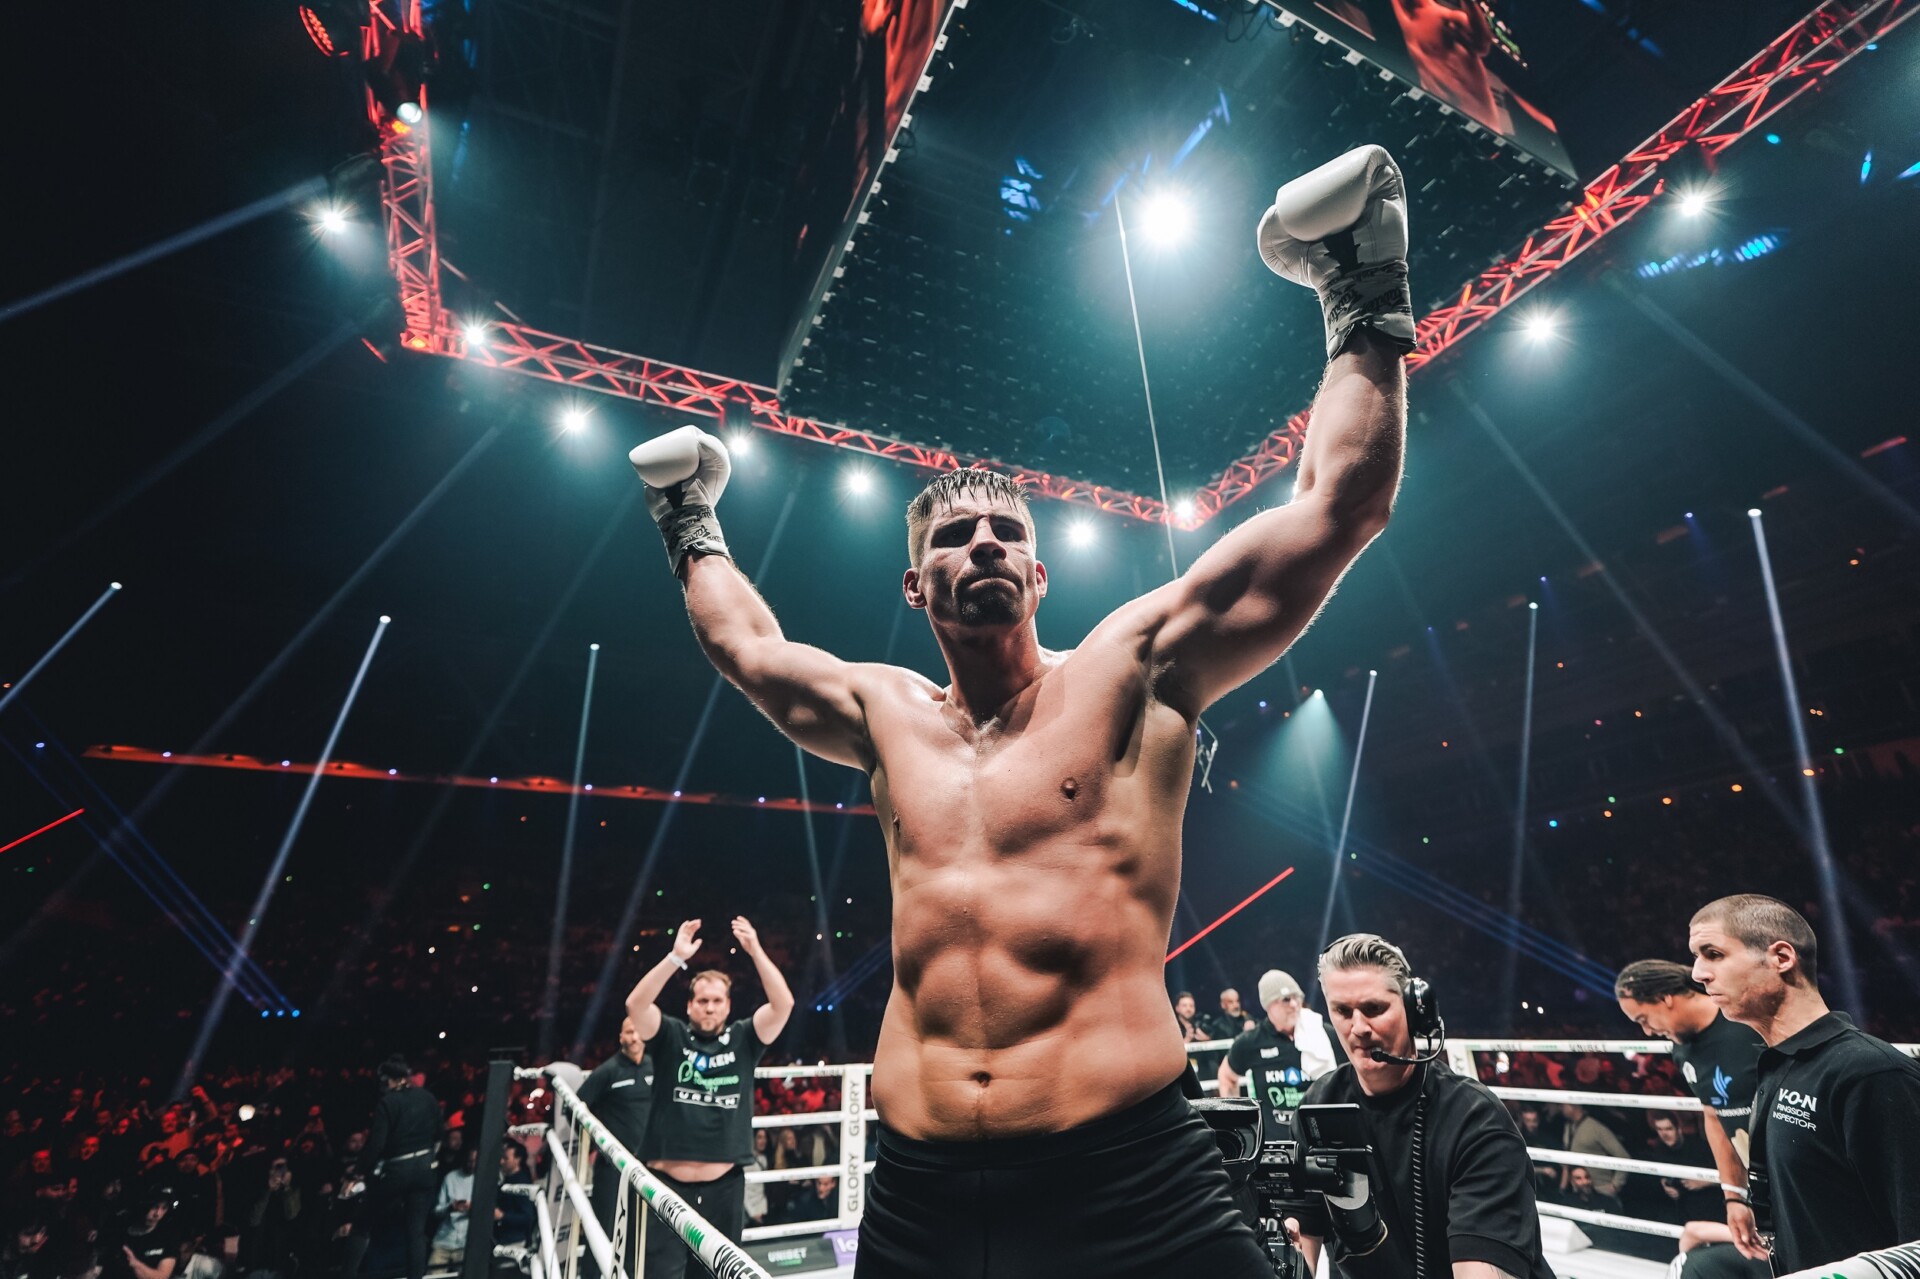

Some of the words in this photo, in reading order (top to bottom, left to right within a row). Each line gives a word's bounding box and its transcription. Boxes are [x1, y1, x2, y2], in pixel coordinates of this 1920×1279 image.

[849, 1080, 860, 1137] GLORY
[1776, 1103, 1811, 1120] RINGSIDE
[1772, 1111, 1817, 1131] INSPECTOR
[847, 1153, 858, 1213] GLORY
[768, 1247, 807, 1263] UNIBET
